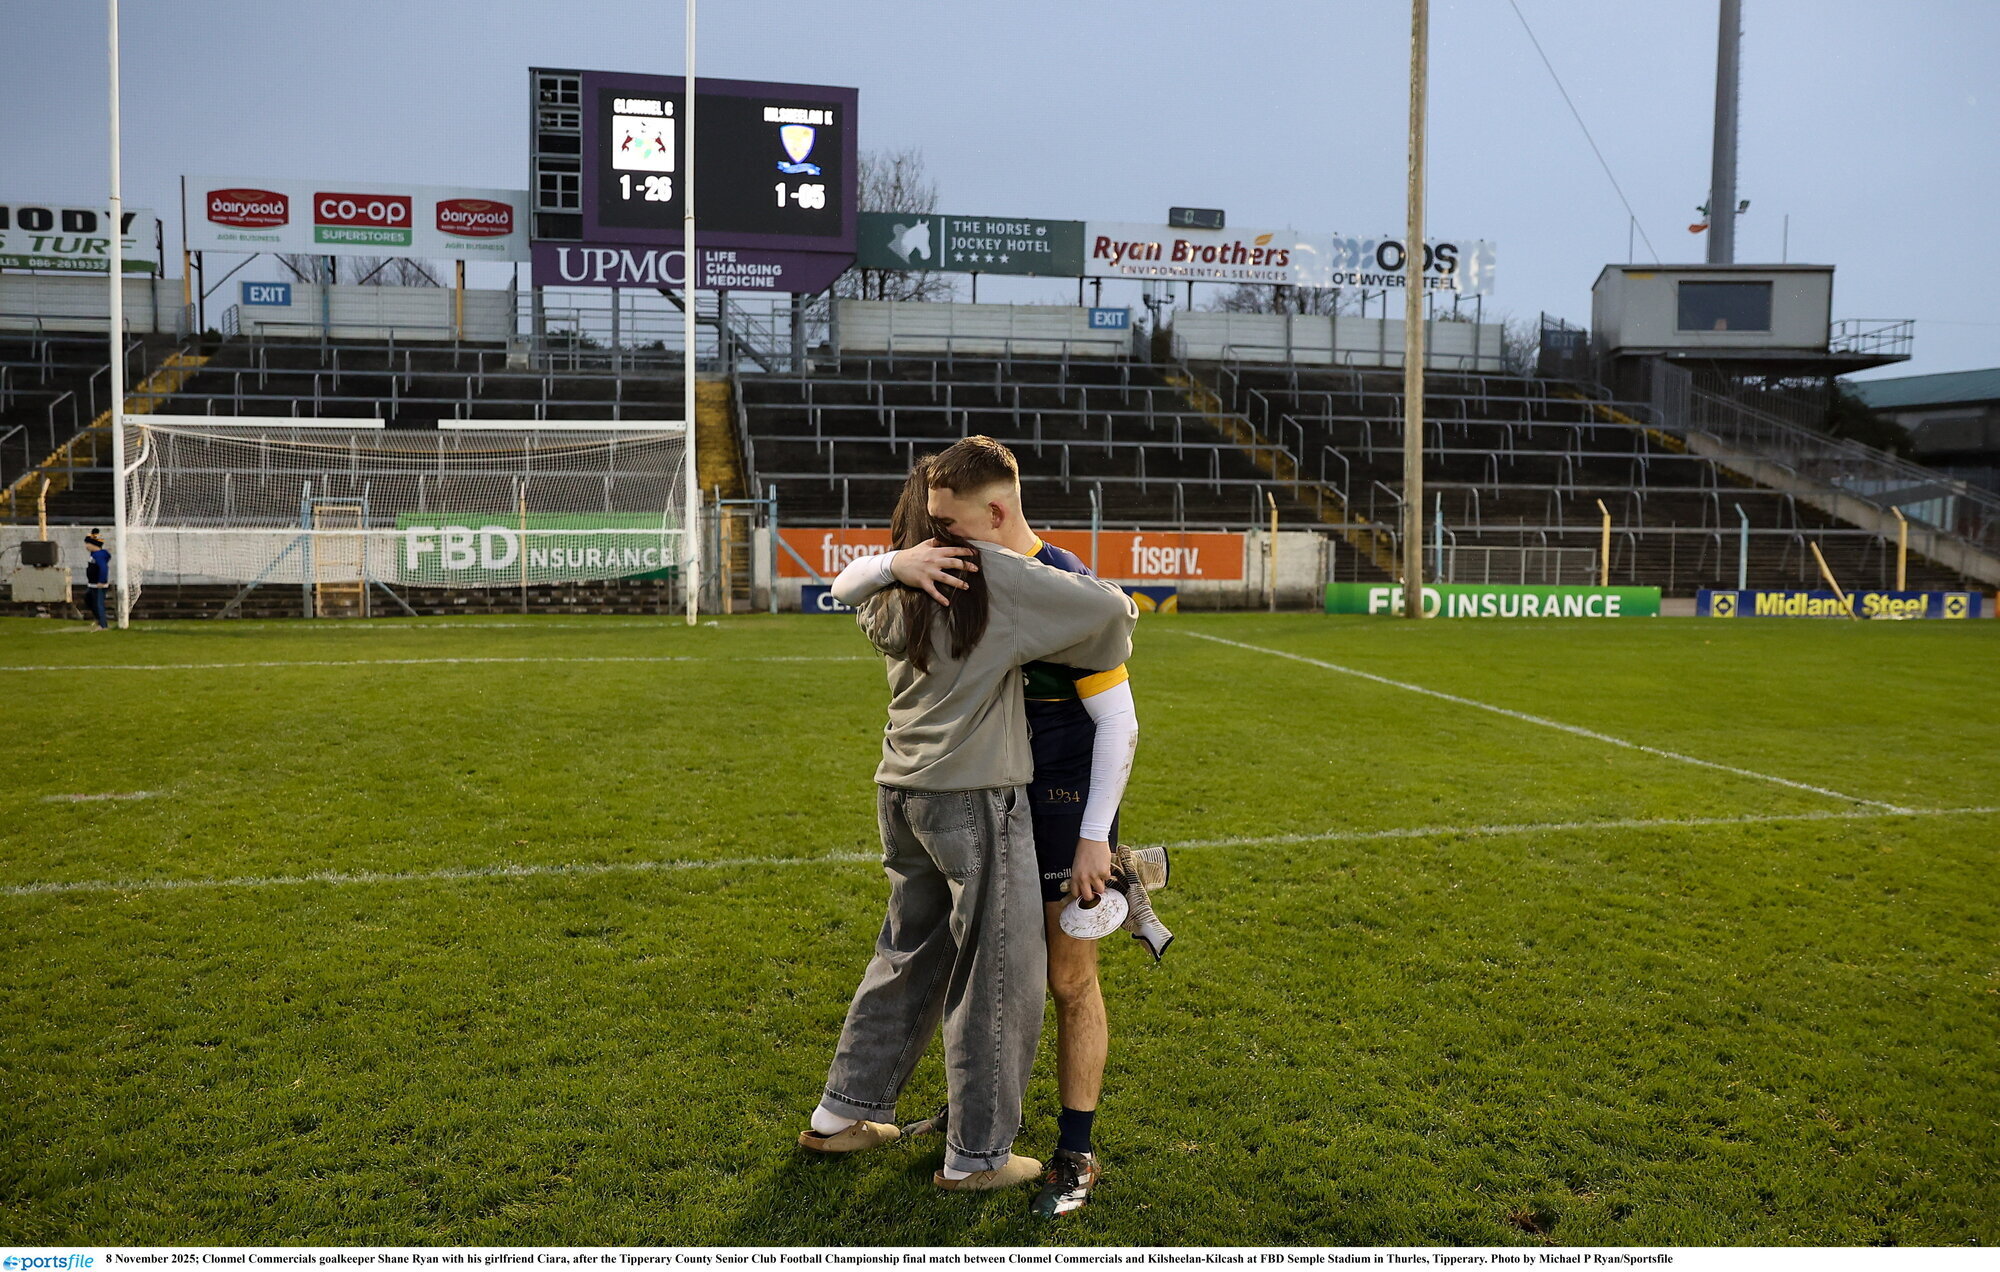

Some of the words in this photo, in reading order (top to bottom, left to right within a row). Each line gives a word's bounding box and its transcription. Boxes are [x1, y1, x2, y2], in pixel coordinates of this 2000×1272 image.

[0, 206, 137, 235] ODY
[321, 229, 405, 242] SUPERSTORES
[953, 221, 981, 233] THE
[986, 222, 1031, 236] HORSE
[951, 237, 1002, 250] JOCKEY
[1007, 239, 1051, 252] HOTEL
[1093, 236, 1163, 266] Ryan
[1171, 240, 1290, 267] Brothers
[706, 251, 737, 262] LIFE
[557, 247, 686, 284] UPMC
[706, 262, 783, 276] CHANGING
[1121, 265, 1228, 278] ENVIRONMENTAL
[1232, 269, 1288, 281] SERVICES
[706, 275, 776, 287] MEDICINE
[1423, 276, 1458, 290] TEEL
[250, 286, 286, 302] EXIT
[1095, 312, 1125, 326] EXIT
[405, 525, 519, 570] FBD
[1448, 593, 1621, 618] INSURANCE
[1755, 592, 1855, 616] Midland
[1862, 593, 1929, 617] Steel
[1048, 788, 1081, 803] 1934
[1044, 868, 1073, 880] oneill
